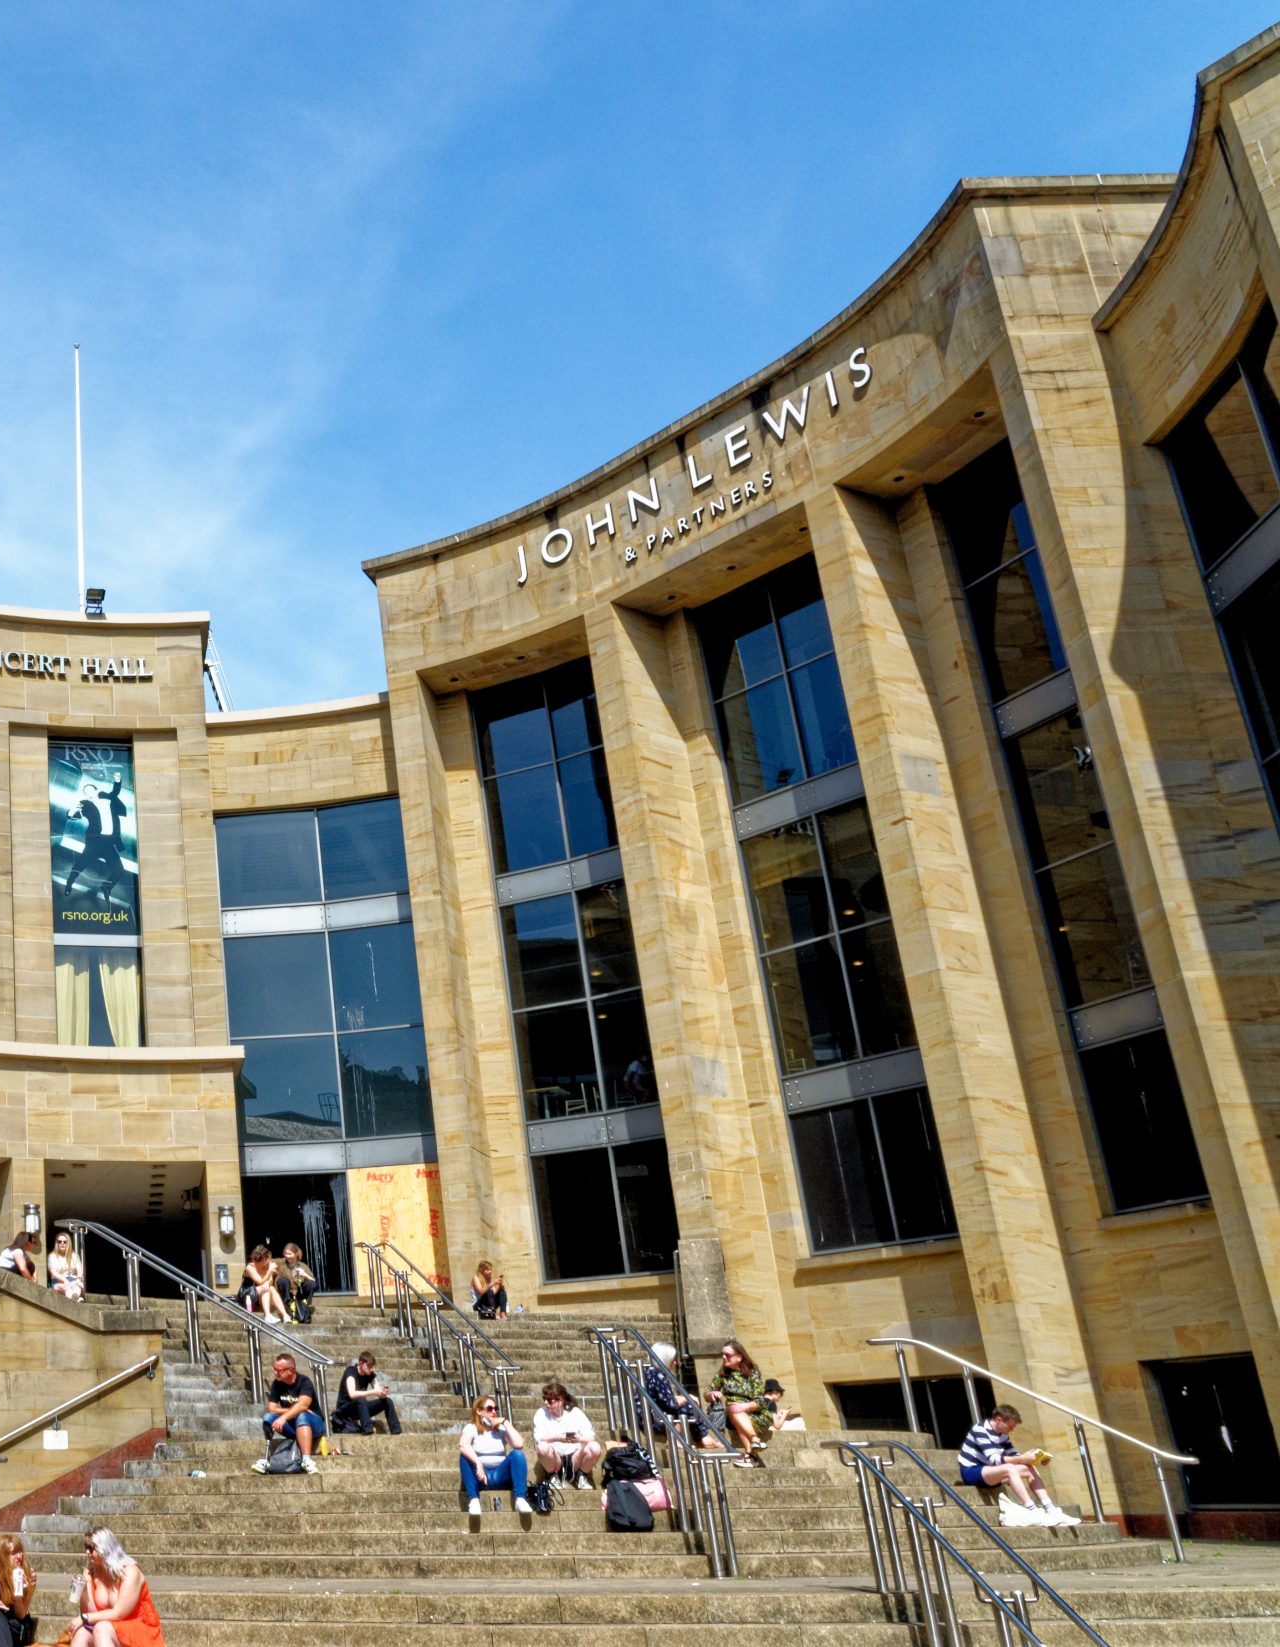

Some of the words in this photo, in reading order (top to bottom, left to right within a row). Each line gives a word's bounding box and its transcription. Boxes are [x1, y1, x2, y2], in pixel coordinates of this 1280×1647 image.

[516, 477, 660, 584] JOHN
[687, 346, 872, 488] LEWIS
[624, 545, 637, 563] &
[646, 471, 774, 550] PARTNERS
[81, 656, 154, 678] HALL
[62, 910, 129, 925] rsno.org.uk
[366, 1171, 395, 1183] Hurry
[415, 1167, 438, 1180] Hurr
